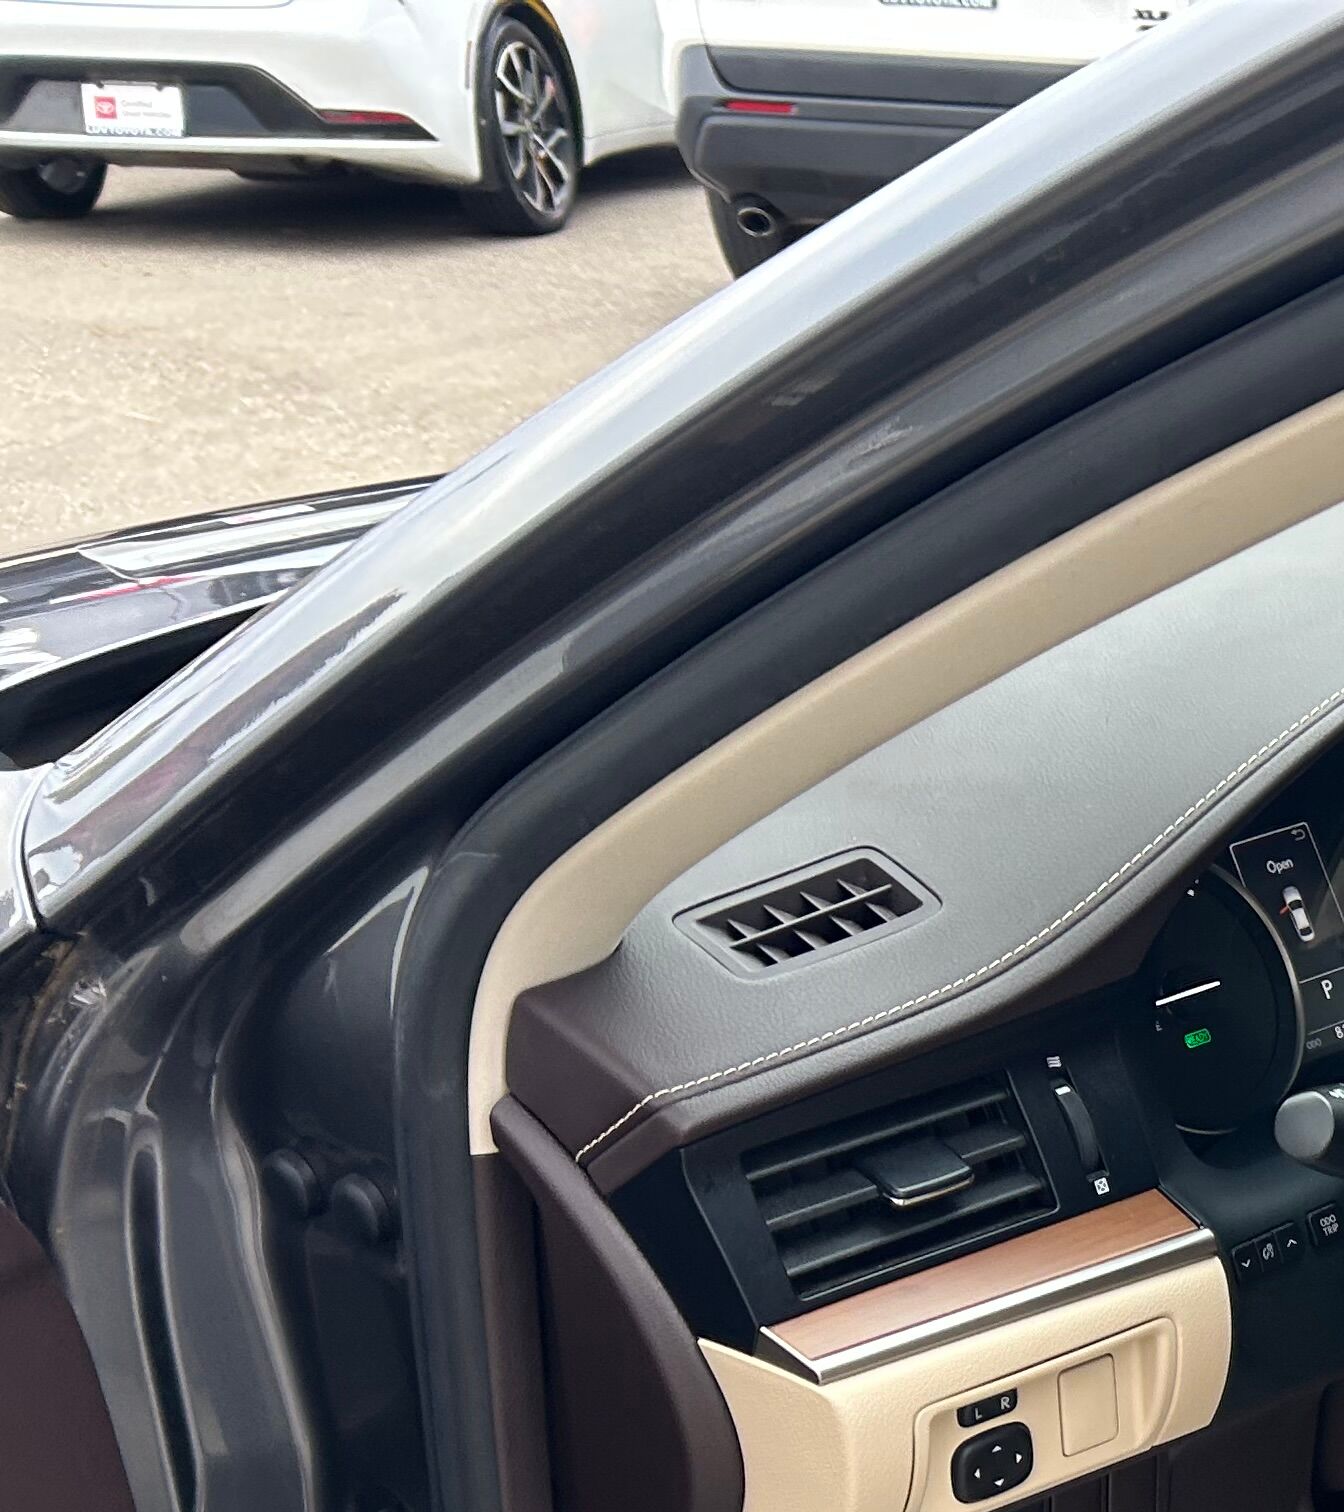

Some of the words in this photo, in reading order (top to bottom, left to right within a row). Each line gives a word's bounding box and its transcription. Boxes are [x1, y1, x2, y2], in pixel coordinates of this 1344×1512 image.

[1266, 859, 1294, 875] Open
[1320, 979, 1334, 1000] P
[1319, 1213, 1337, 1227] ODO
[1322, 1222, 1339, 1236] TRIP
[974, 1407, 983, 1420] L
[1000, 1396, 1010, 1410] R
